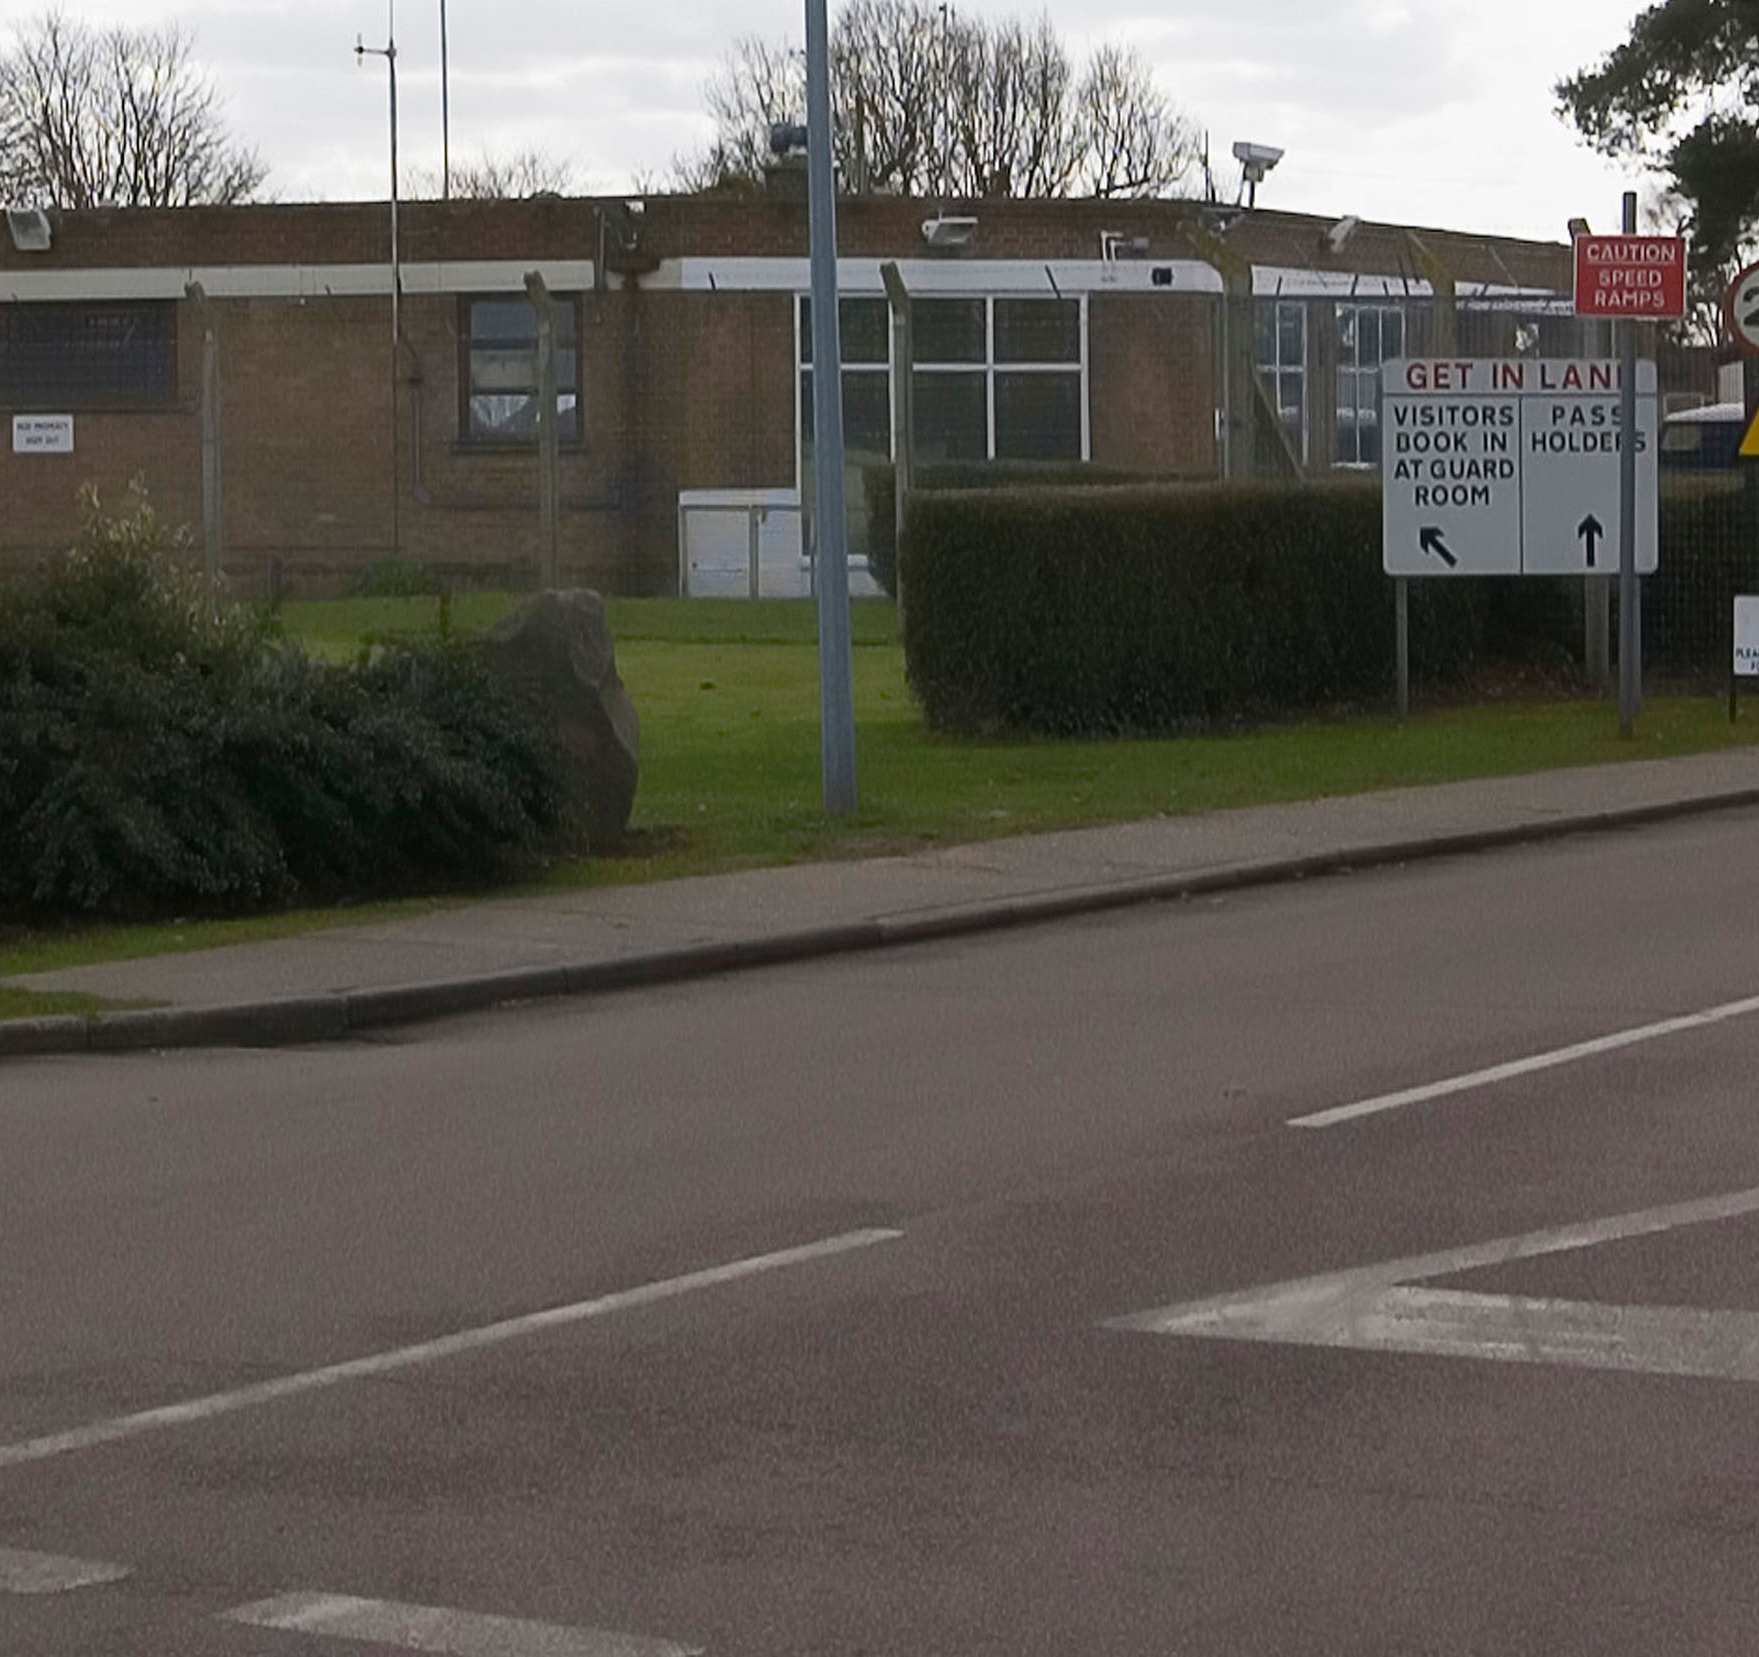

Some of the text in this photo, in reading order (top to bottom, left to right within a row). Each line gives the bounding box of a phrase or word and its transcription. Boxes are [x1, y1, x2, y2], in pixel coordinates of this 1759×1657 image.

[1587, 244, 1675, 262] CAUTION
[1599, 270, 1662, 287] SPEED
[1595, 289, 1665, 308] RAMPS
[1406, 363, 1474, 390] GET
[1493, 363, 1524, 390] IN
[1394, 406, 1514, 426] VISITORS
[1552, 406, 1622, 426] PASS
[1396, 431, 1507, 453] BOOK IN
[1394, 459, 1515, 479] AT GUARD
[1415, 485, 1490, 507] ROOM
